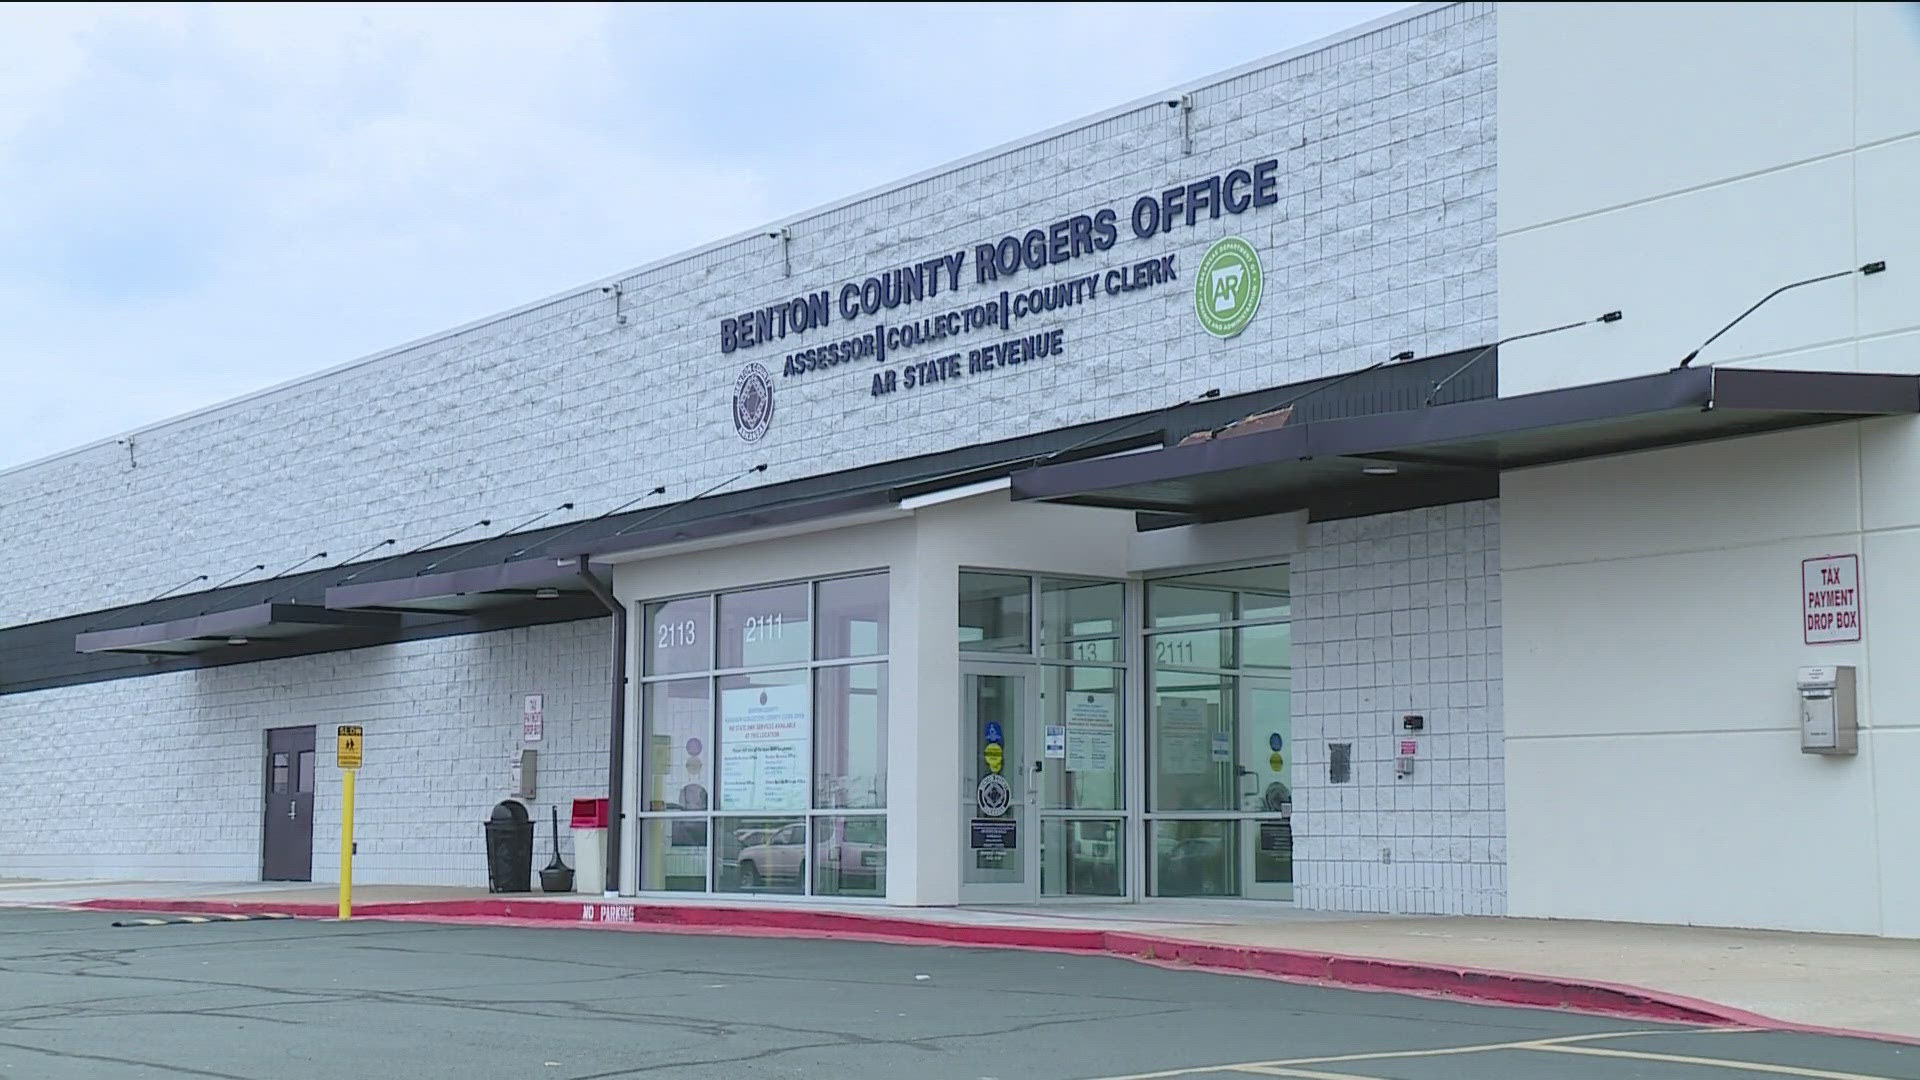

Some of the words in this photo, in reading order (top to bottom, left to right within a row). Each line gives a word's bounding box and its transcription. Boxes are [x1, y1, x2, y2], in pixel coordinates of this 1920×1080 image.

[721, 291, 829, 353] BENTON
[839, 251, 965, 320] COUNTY
[975, 209, 1117, 284] ROGERS
[1132, 159, 1278, 238] OFFICE
[1214, 275, 1239, 300] AR
[783, 334, 874, 377] ASSESSOR
[887, 301, 998, 350] COLLECTOR
[1013, 273, 1100, 317] COUNTY
[1104, 253, 1177, 295] CLERK
[871, 369, 897, 397] AR
[903, 353, 961, 389] STATE
[968, 329, 1064, 374] REVENUE
[1821, 567, 1840, 585] TAX
[1809, 589, 1854, 608] PAYMENT
[746, 612, 782, 642] 2111
[1807, 613, 1833, 630] DROP
[1836, 611, 1857, 629] BOX
[658, 620, 696, 648] 2113
[1156, 640, 1193, 663] 2111
[340, 726, 361, 736] SLOW
[582, 904, 594, 920] NO
[600, 905, 634, 922] PARKING
